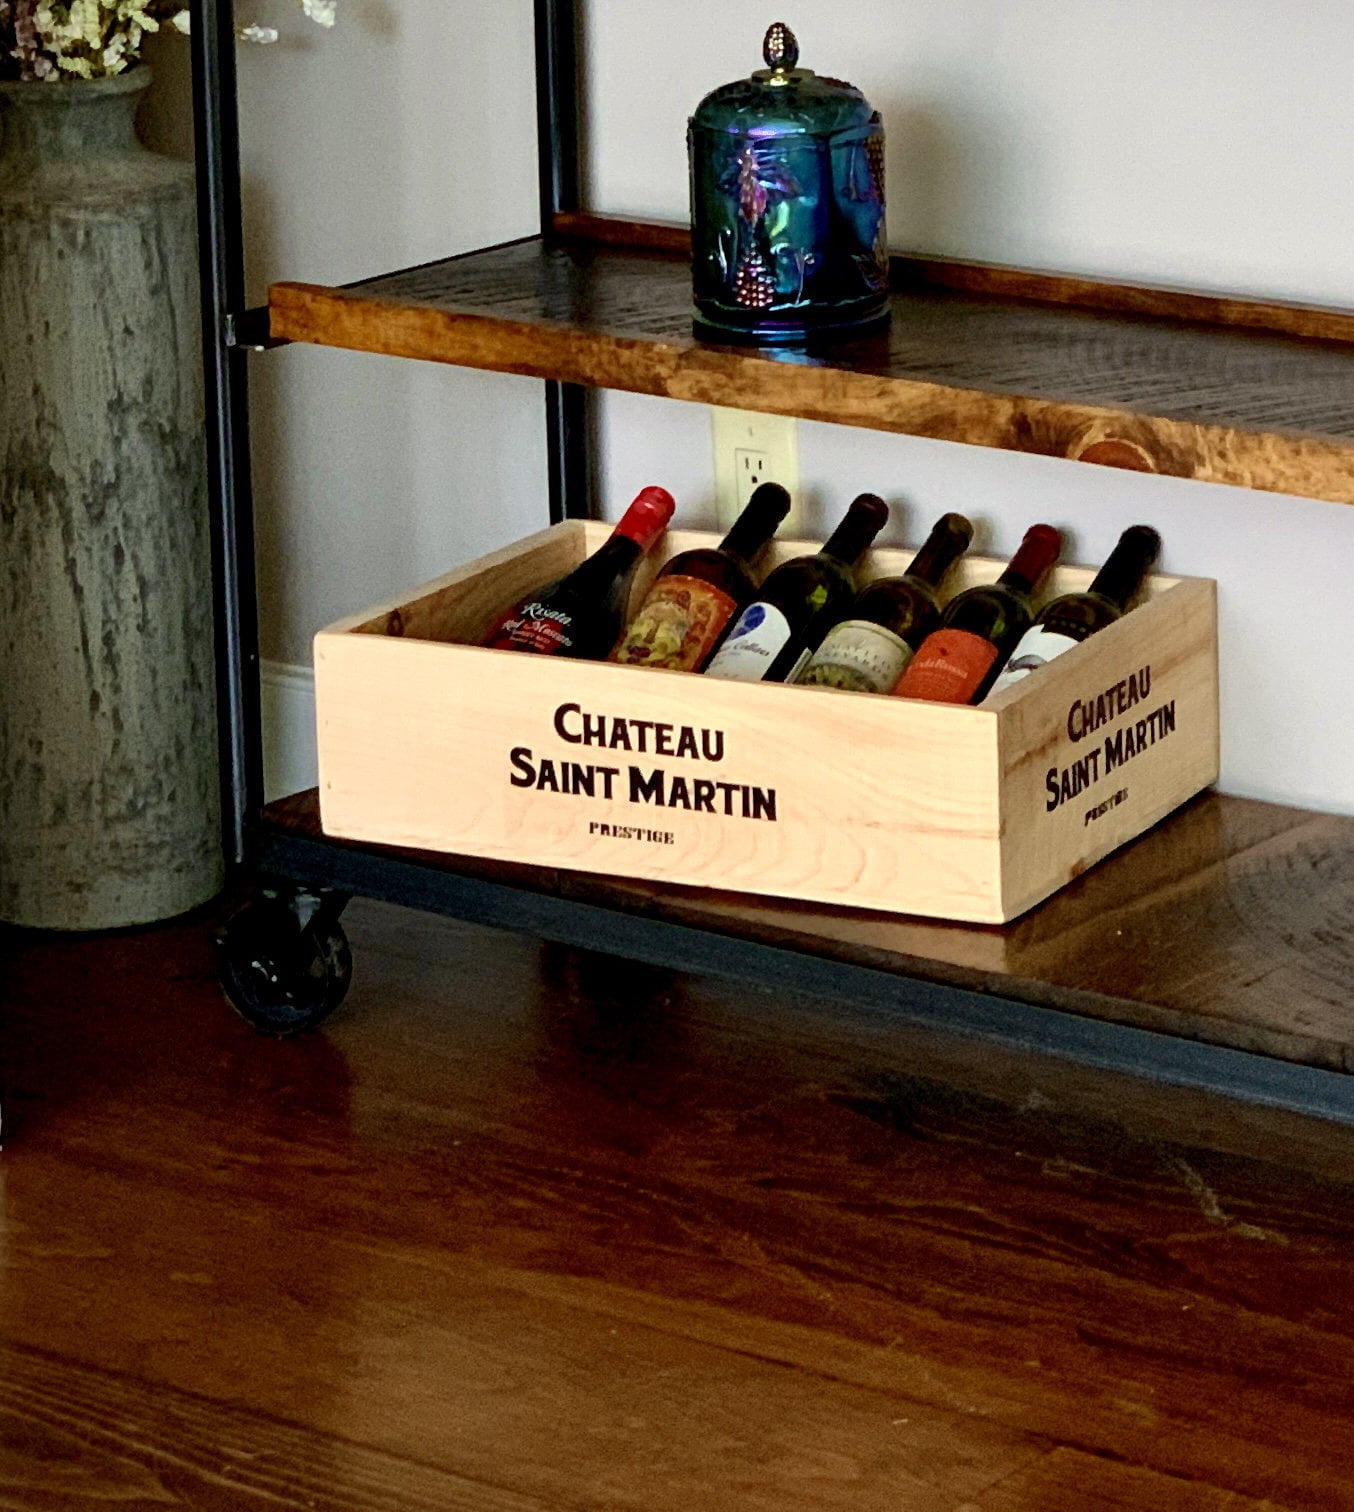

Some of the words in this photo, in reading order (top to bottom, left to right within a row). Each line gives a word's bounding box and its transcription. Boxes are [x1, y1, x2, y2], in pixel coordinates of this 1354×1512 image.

[553, 702, 725, 763] CHATEAU
[1067, 665, 1151, 743] CHATEAU
[509, 746, 619, 800] SAINT
[628, 765, 778, 822] MARTIN
[1045, 747, 1101, 812] SAINT
[1105, 700, 1176, 776] MARTIN
[588, 820, 675, 846] PRESTIGE
